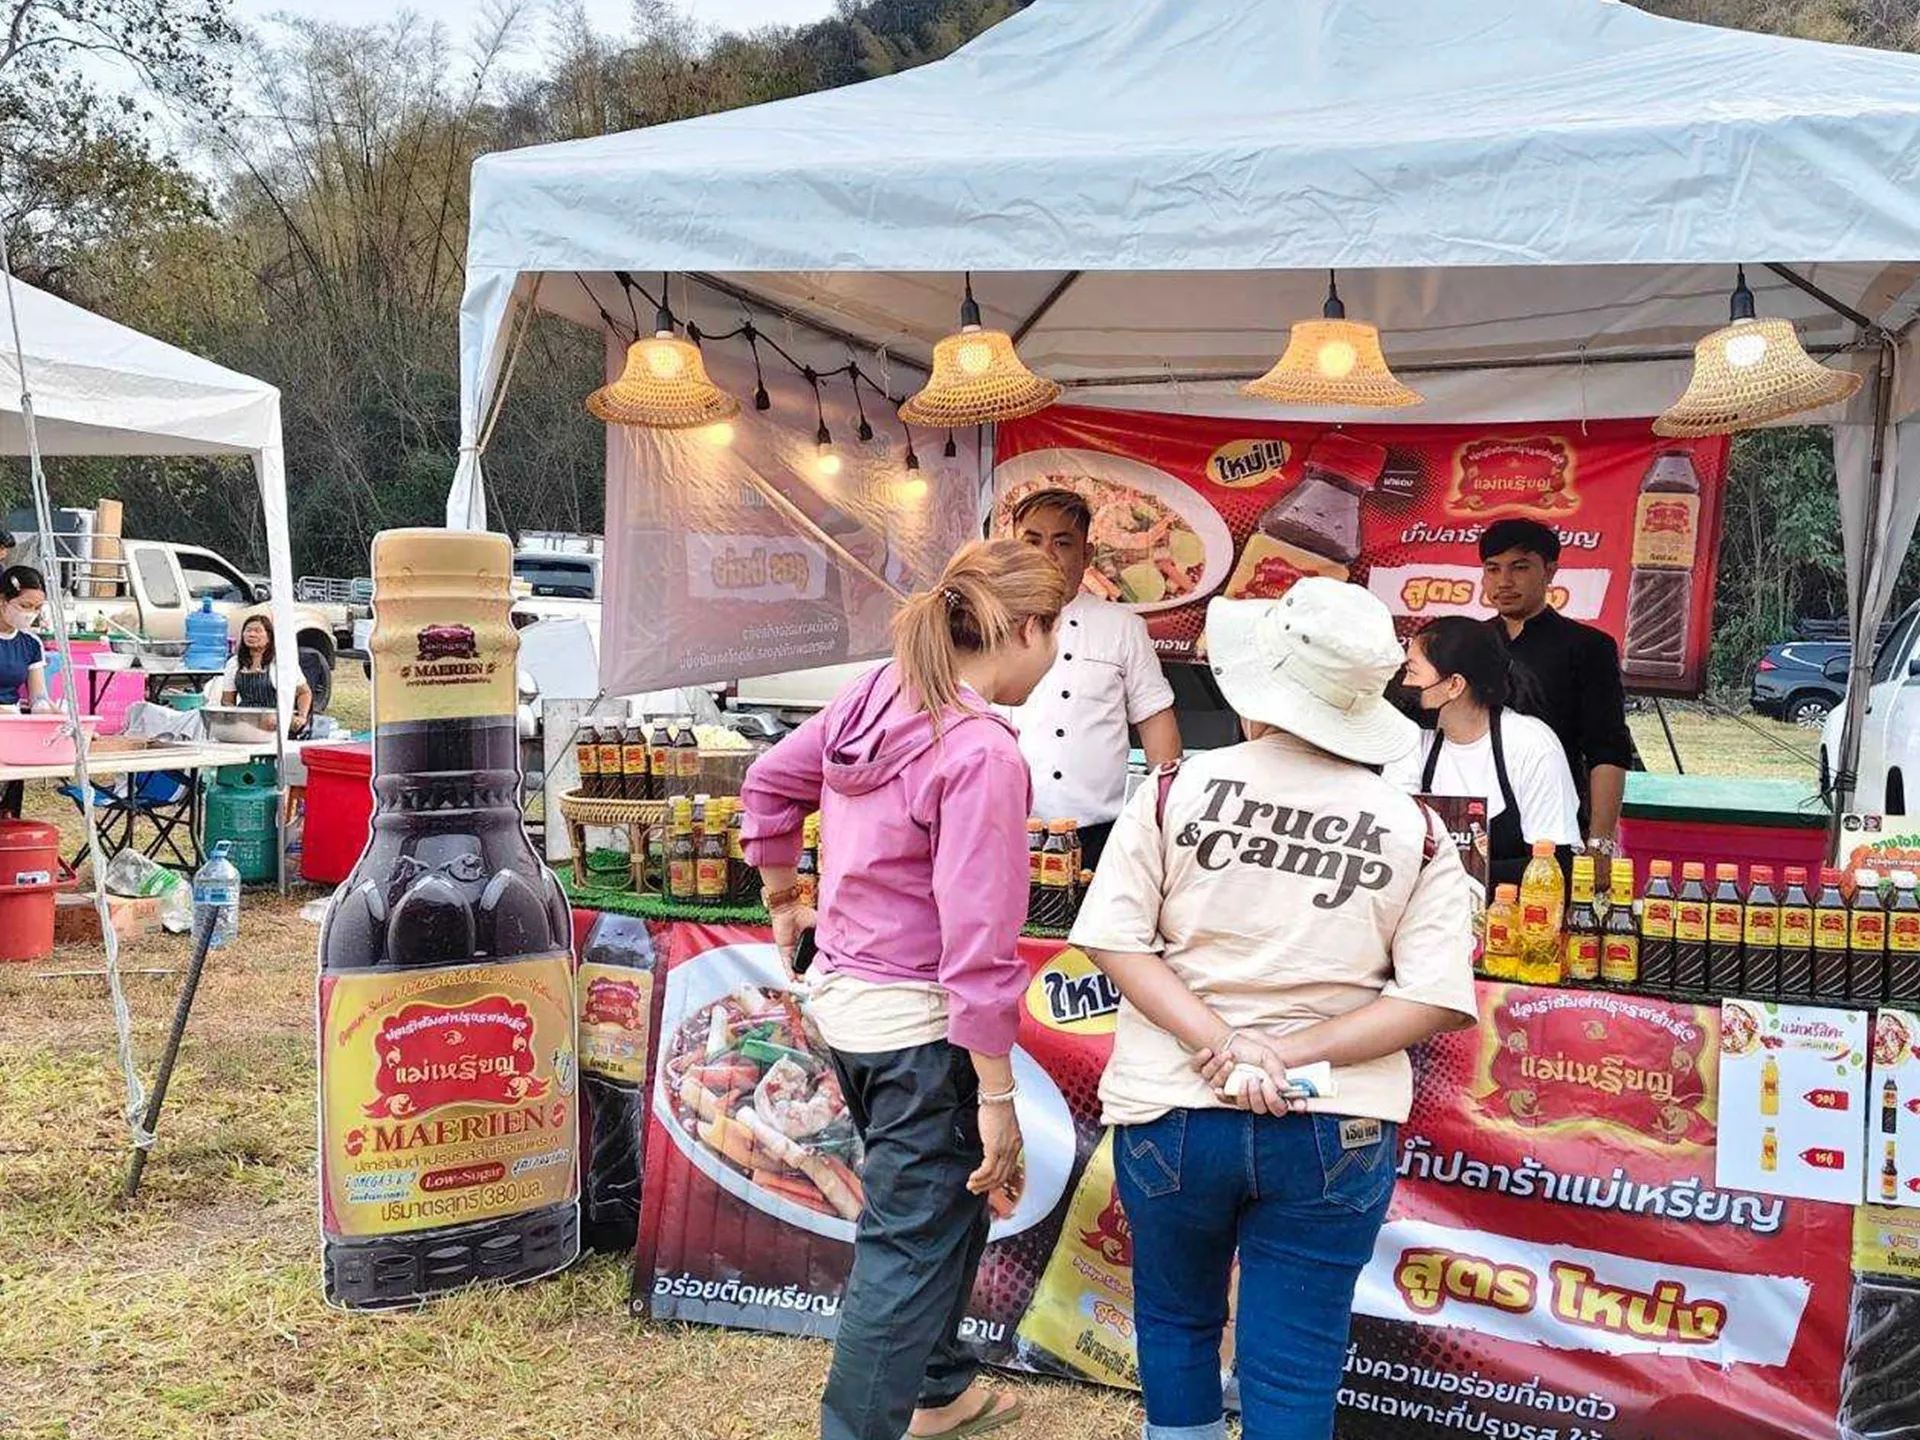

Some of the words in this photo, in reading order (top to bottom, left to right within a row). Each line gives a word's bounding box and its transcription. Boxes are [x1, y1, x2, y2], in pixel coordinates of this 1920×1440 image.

[1215, 440, 1286, 483] ใหม่!!
[1402, 578, 1474, 613] สูตร
[414, 663, 484, 677] MAERIEN
[1200, 778, 1391, 854] Truck
[1176, 822, 1200, 847] &
[1196, 829, 1393, 910] Camp
[395, 1053, 520, 1085] แม่เหรียญ
[1520, 1051, 1678, 1103] แม่เหรียญ
[372, 1105, 546, 1153] MAERIEN
[424, 1165, 504, 1189] Low-Sugar
[483, 1181, 518, 1208] 380
[654, 1272, 840, 1316] อร่อยติดเหรียญ
[1398, 1250, 1535, 1311] สูตร
[1552, 1262, 1723, 1341] โหน่ง
